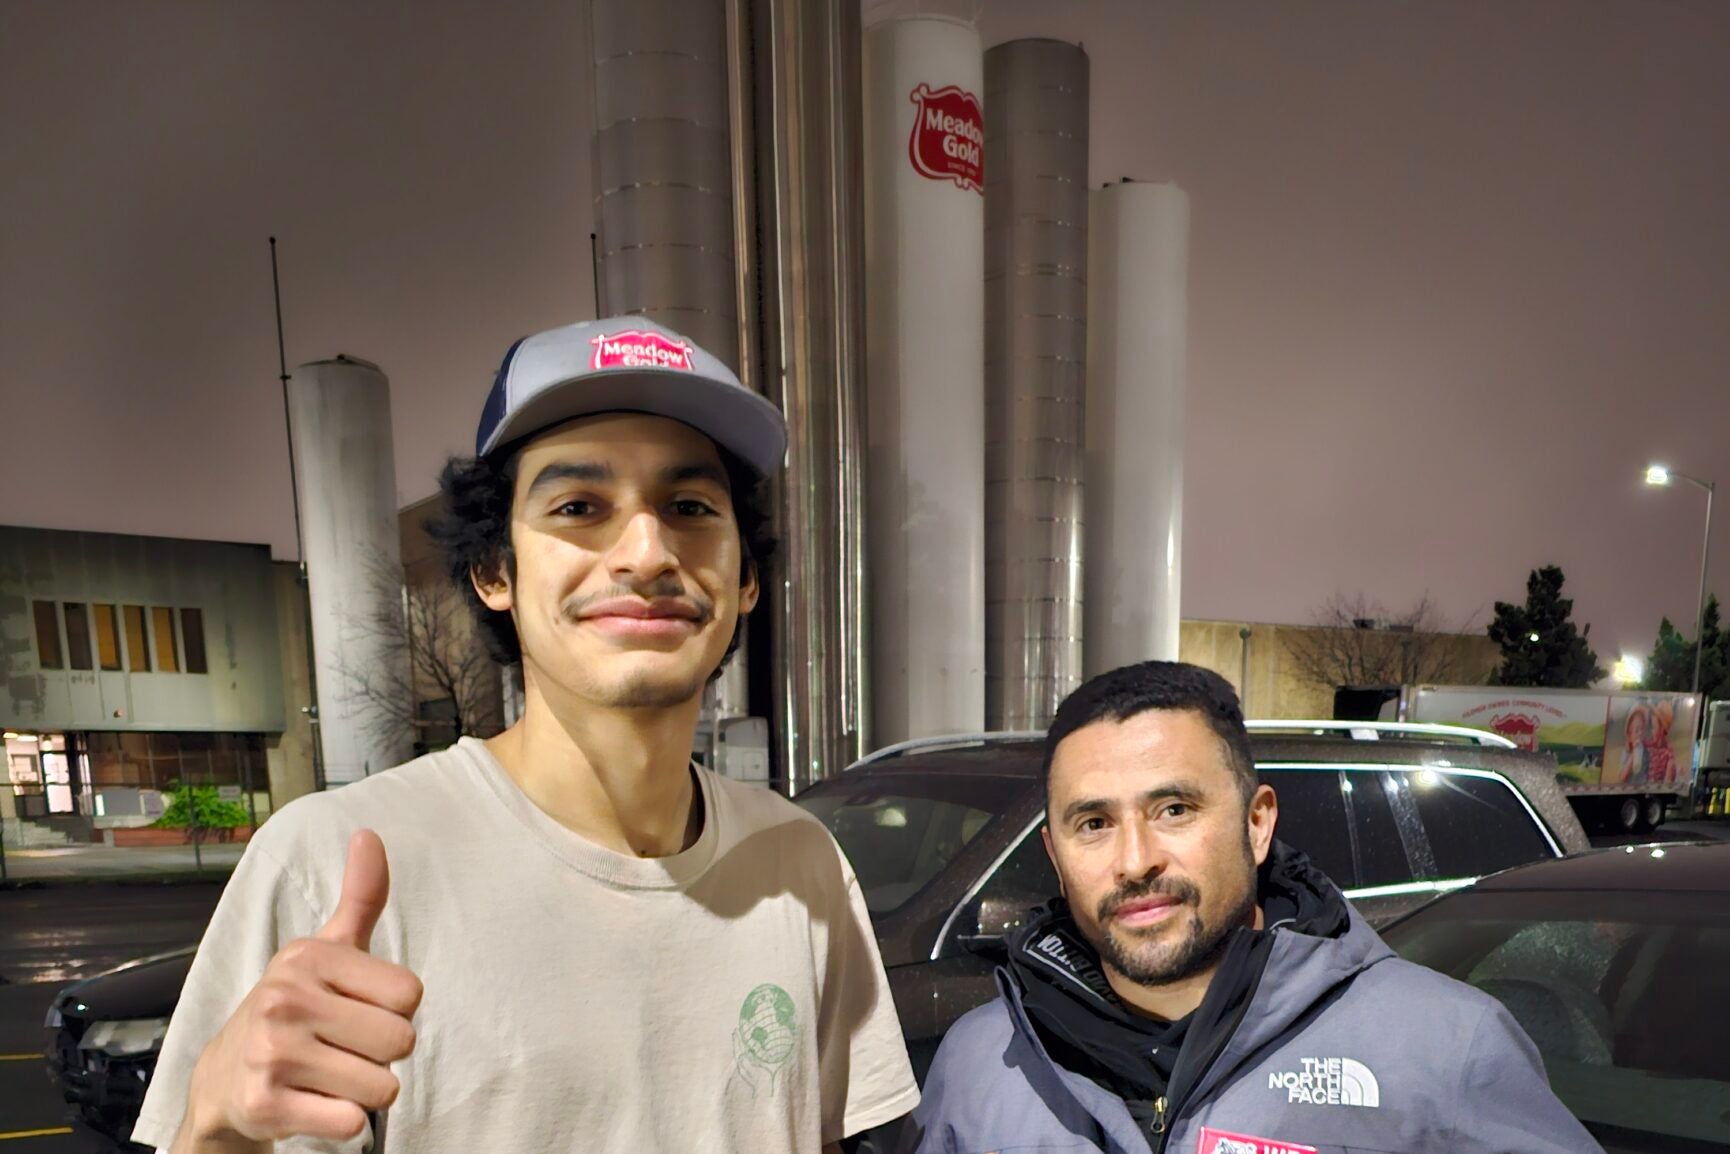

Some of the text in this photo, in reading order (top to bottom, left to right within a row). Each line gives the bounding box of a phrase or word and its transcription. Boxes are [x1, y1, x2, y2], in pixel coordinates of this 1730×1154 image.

[942, 134, 979, 167] Gold
[604, 342, 683, 363] Meadow
[1301, 1057, 1342, 1074] THE
[1269, 1071, 1341, 1090] NORTH
[1288, 1089, 1341, 1105] FACE
